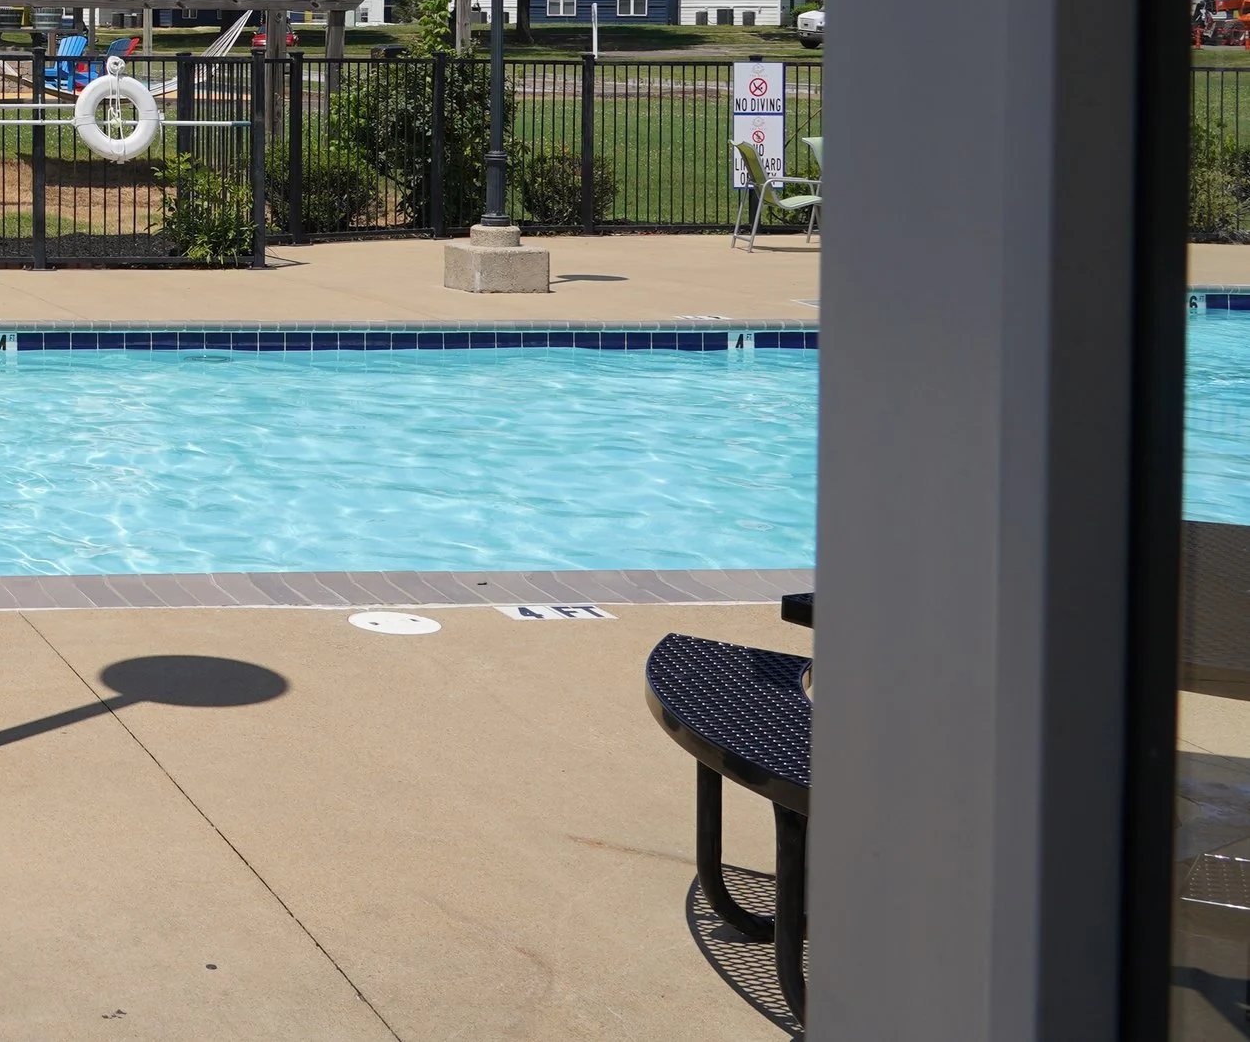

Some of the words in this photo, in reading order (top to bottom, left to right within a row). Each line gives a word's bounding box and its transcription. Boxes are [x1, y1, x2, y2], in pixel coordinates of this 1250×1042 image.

[735, 98, 748, 112] NO
[750, 98, 781, 112] DIVING
[735, 333, 744, 349] 4
[517, 606, 545, 619] 4
[550, 606, 606, 618] FT
